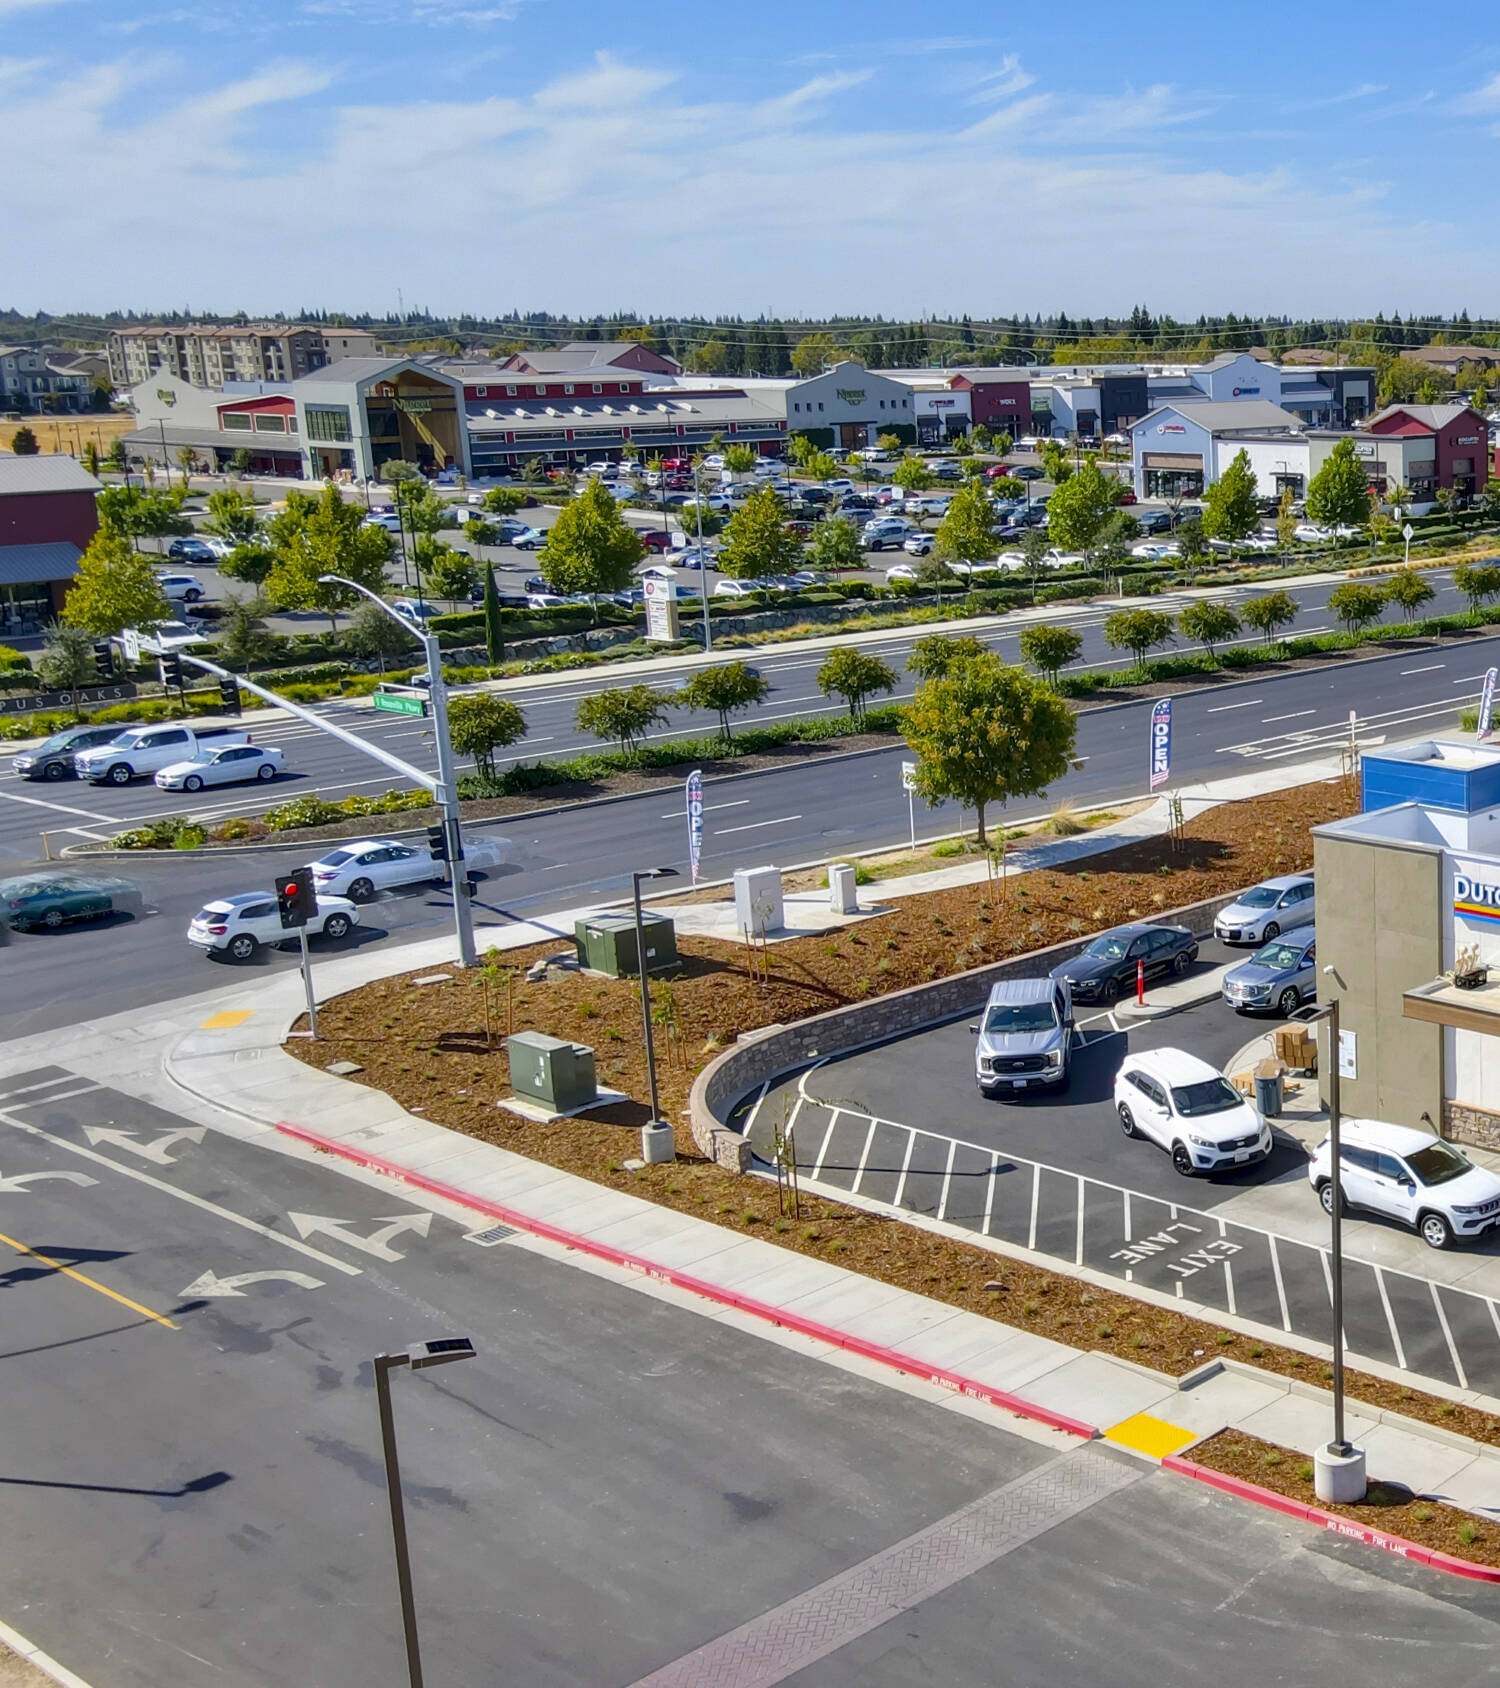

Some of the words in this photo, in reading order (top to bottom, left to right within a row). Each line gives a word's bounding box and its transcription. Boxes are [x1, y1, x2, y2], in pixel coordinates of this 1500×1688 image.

[60, 687, 122, 704] OAKS
[1154, 723, 1169, 773] OPEN
[1109, 1222, 1202, 1264] LANE
[1166, 1239, 1243, 1277] EXIT
[1338, 1523, 1364, 1540] PARKING
[1372, 1536, 1387, 1549] FIRE
[1389, 1542, 1407, 1556] LANE
